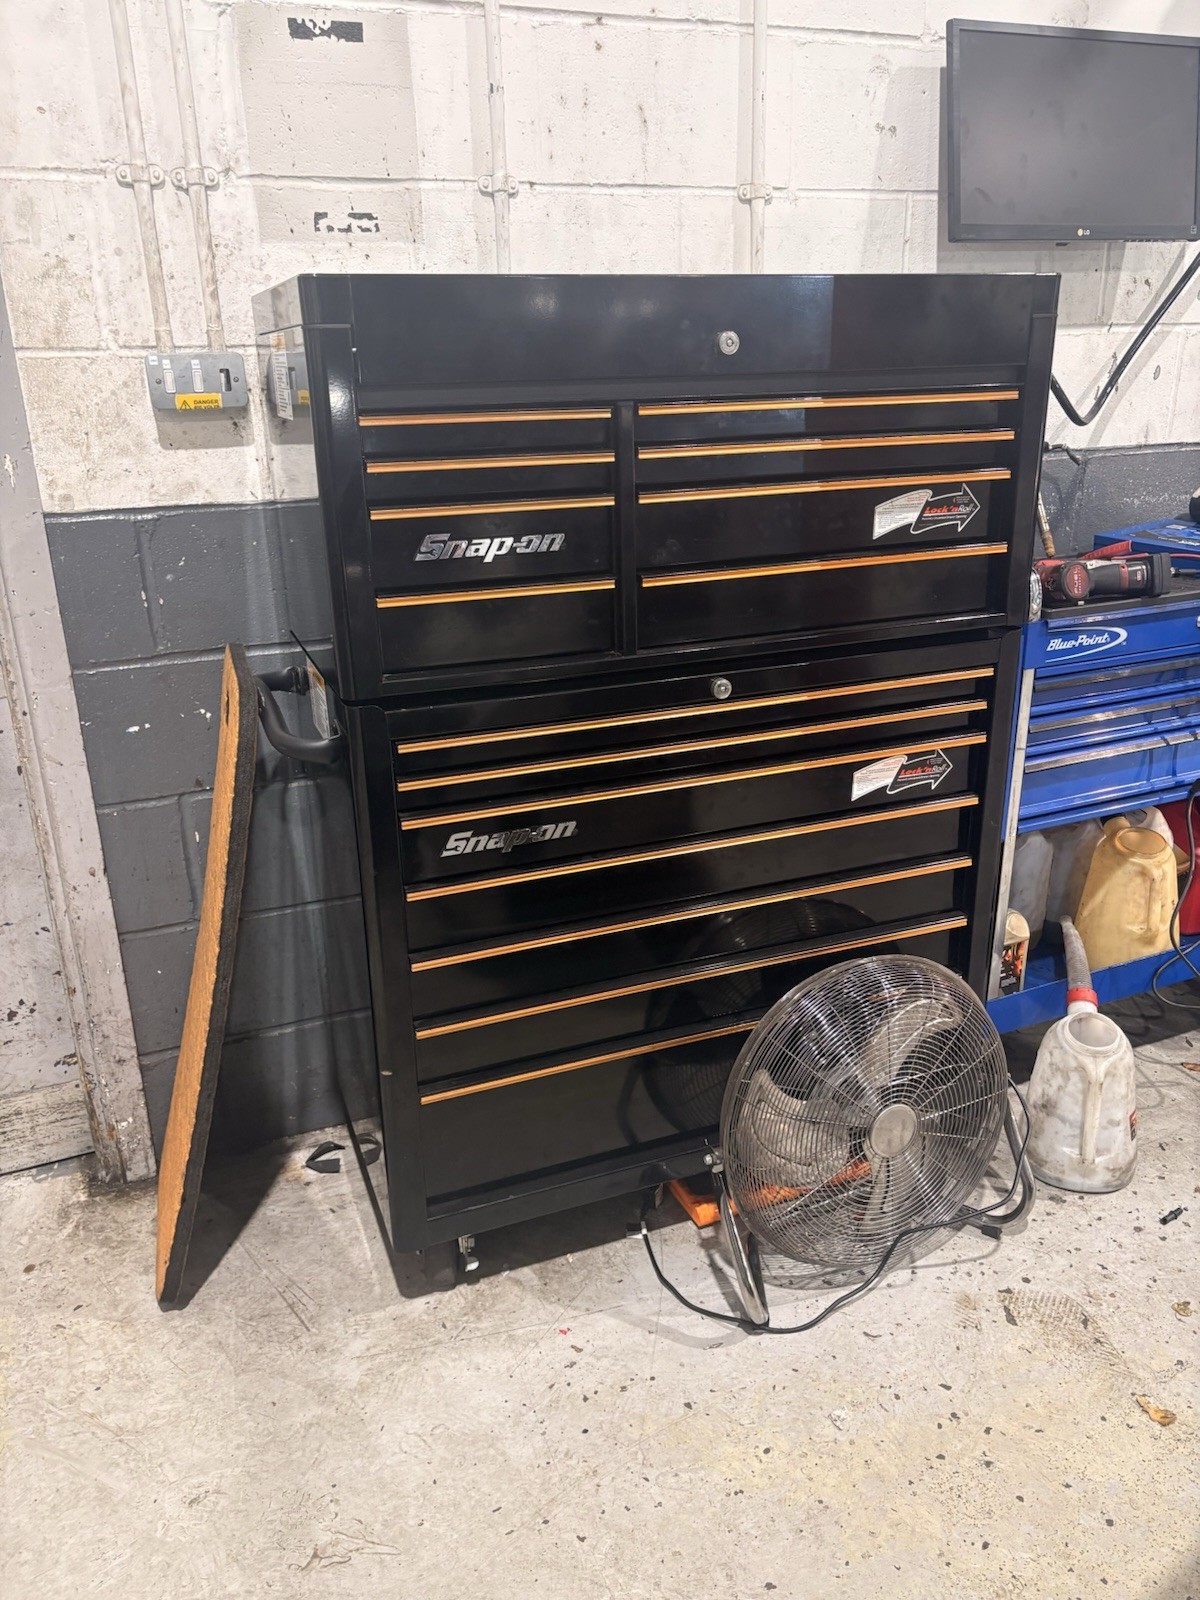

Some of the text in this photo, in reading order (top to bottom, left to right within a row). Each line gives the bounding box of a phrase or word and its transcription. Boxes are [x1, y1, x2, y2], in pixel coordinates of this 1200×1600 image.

[415, 533, 565, 563] Snap-on
[1046, 632, 1109, 651] Blue-Point
[440, 820, 577, 858] Snap-on
